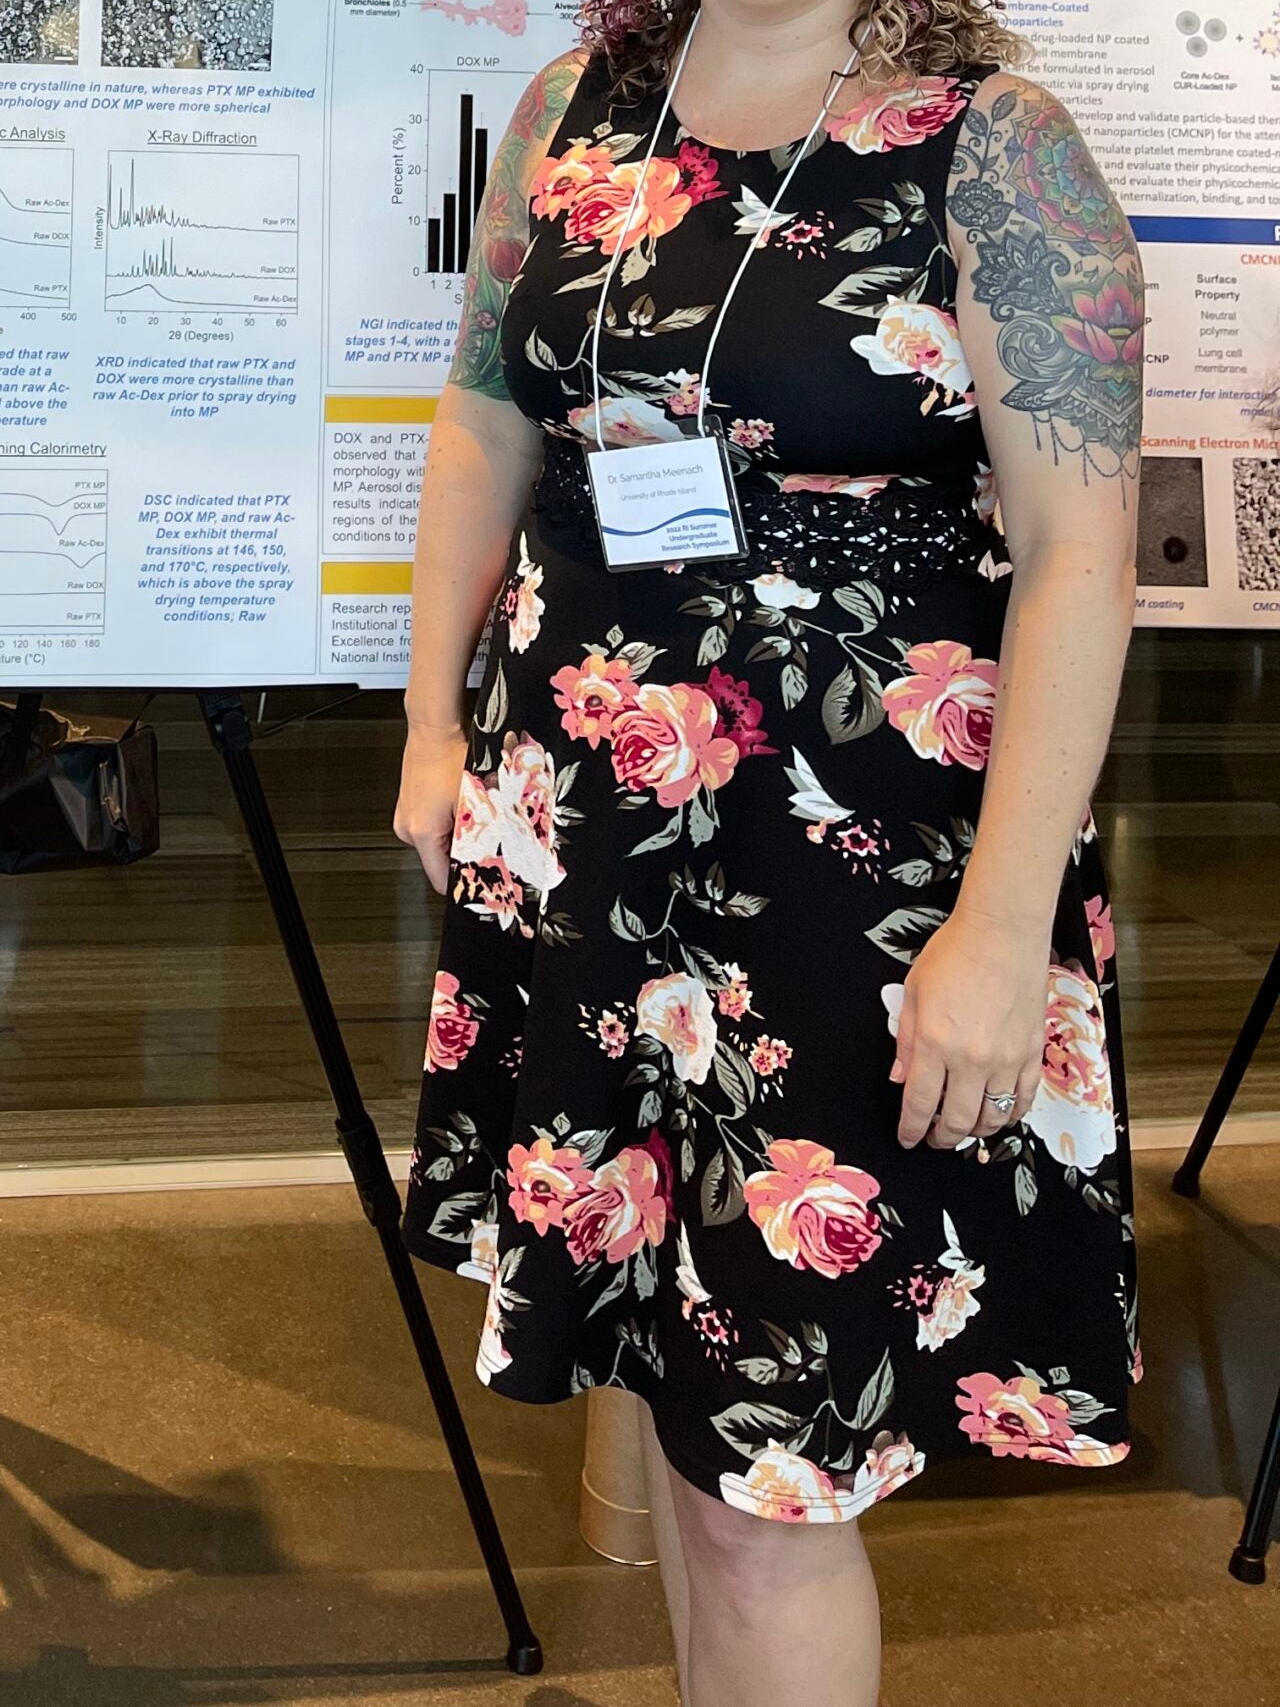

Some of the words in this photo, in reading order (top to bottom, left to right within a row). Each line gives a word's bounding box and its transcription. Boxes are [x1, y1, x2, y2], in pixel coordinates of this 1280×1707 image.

[19, 79, 86, 94] crystalline
[88, 81, 101, 92] in
[103, 82, 148, 97] nature,
[151, 83, 204, 95] whereas
[205, 84, 233, 96] PTX
[234, 85, 256, 96] MP
[256, 85, 316, 98] exhibited
[9, 126, 66, 143] Analysis
[146, 129, 189, 148] X-Ray
[191, 130, 257, 145] Diffraction
[1197, 274, 1237, 284] Surface
[1195, 290, 1240, 301] Property
[29, 441, 107, 459] Calorimetry
[1201, 437, 1249, 449] Electron
